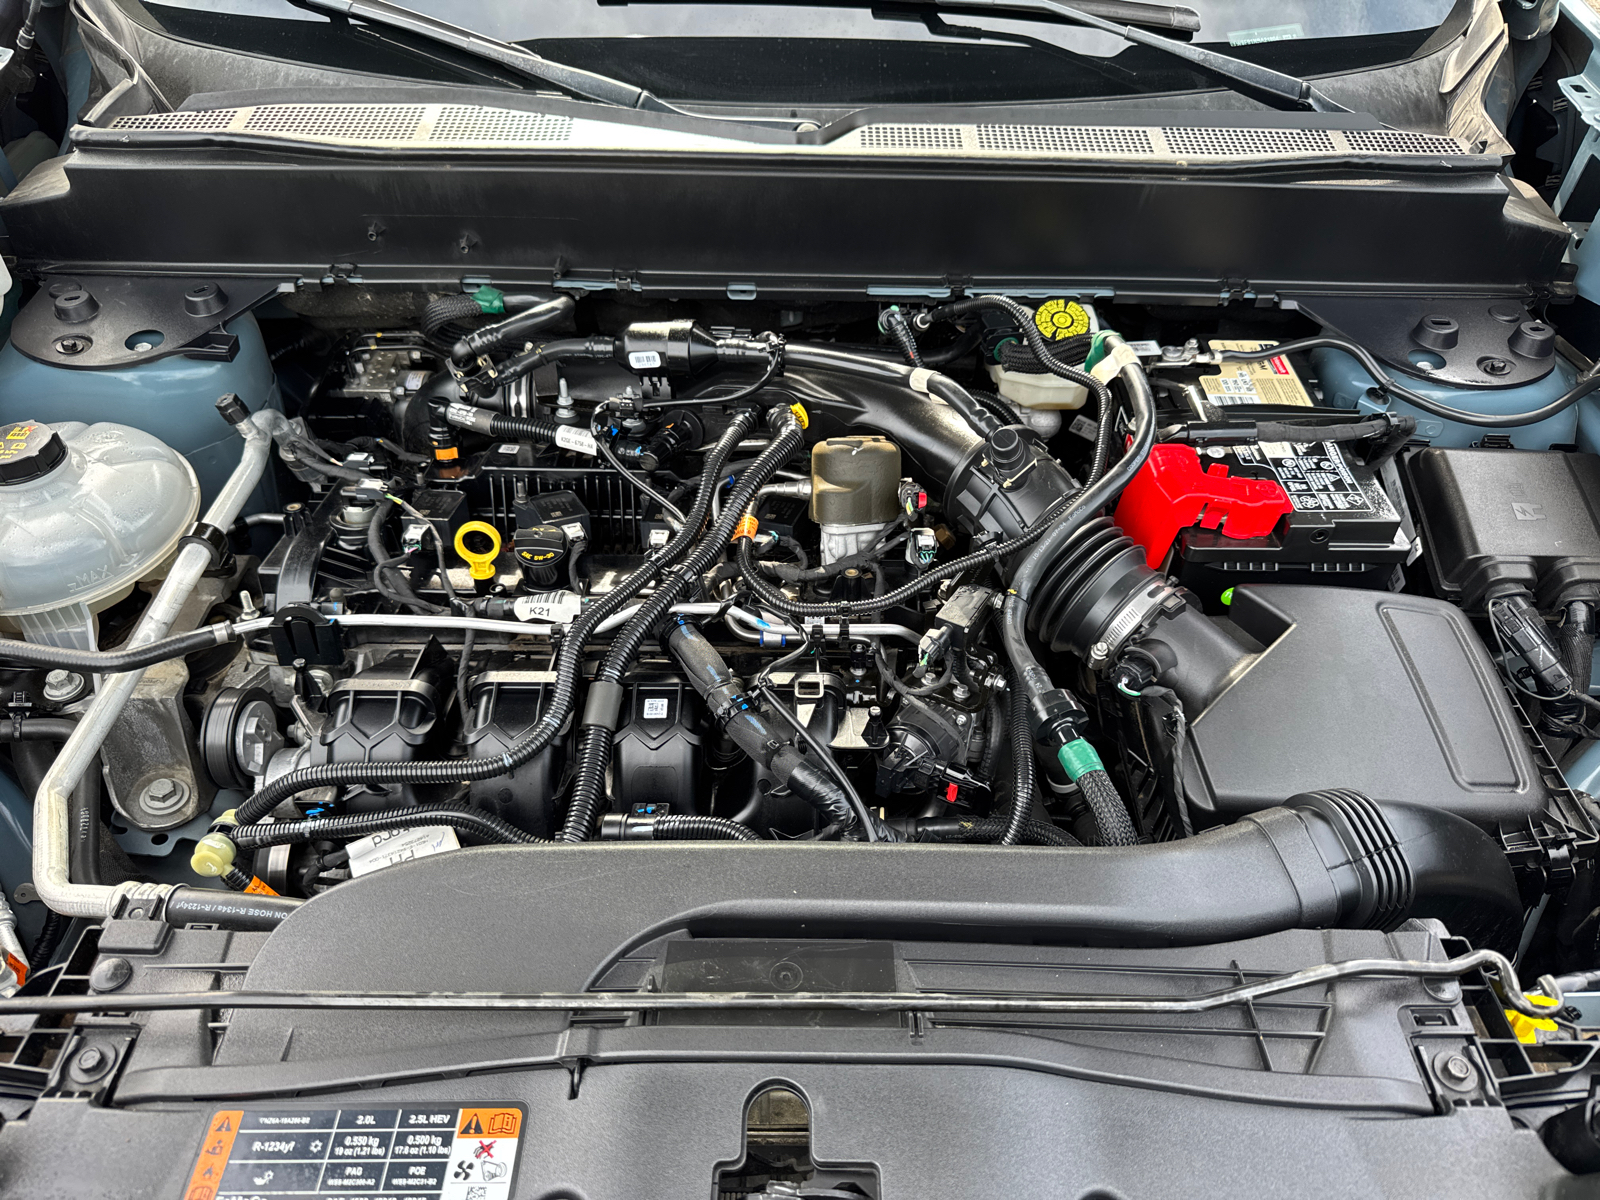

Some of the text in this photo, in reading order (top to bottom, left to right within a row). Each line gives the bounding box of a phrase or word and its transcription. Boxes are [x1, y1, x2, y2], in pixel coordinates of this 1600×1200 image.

[75, 564, 114, 587] MAX
[529, 606, 550, 617] K21
[176, 901, 212, 911] R-1234yf
[218, 905, 246, 914] R-134a
[248, 908, 272, 917] HOSE
[355, 1115, 376, 1124] 2.0L
[408, 1114, 450, 1124] 2.5L HEV
[344, 1136, 379, 1146] 0.550 kg
[407, 1135, 442, 1146] 0.500 kg
[252, 1141, 296, 1154] R-1234yf
[334, 1147, 343, 1155] 19
[371, 1147, 385, 1157] lbs)
[437, 1146, 451, 1155] lbs)
[344, 1166, 363, 1176] PAG
[408, 1166, 427, 1175] POE
